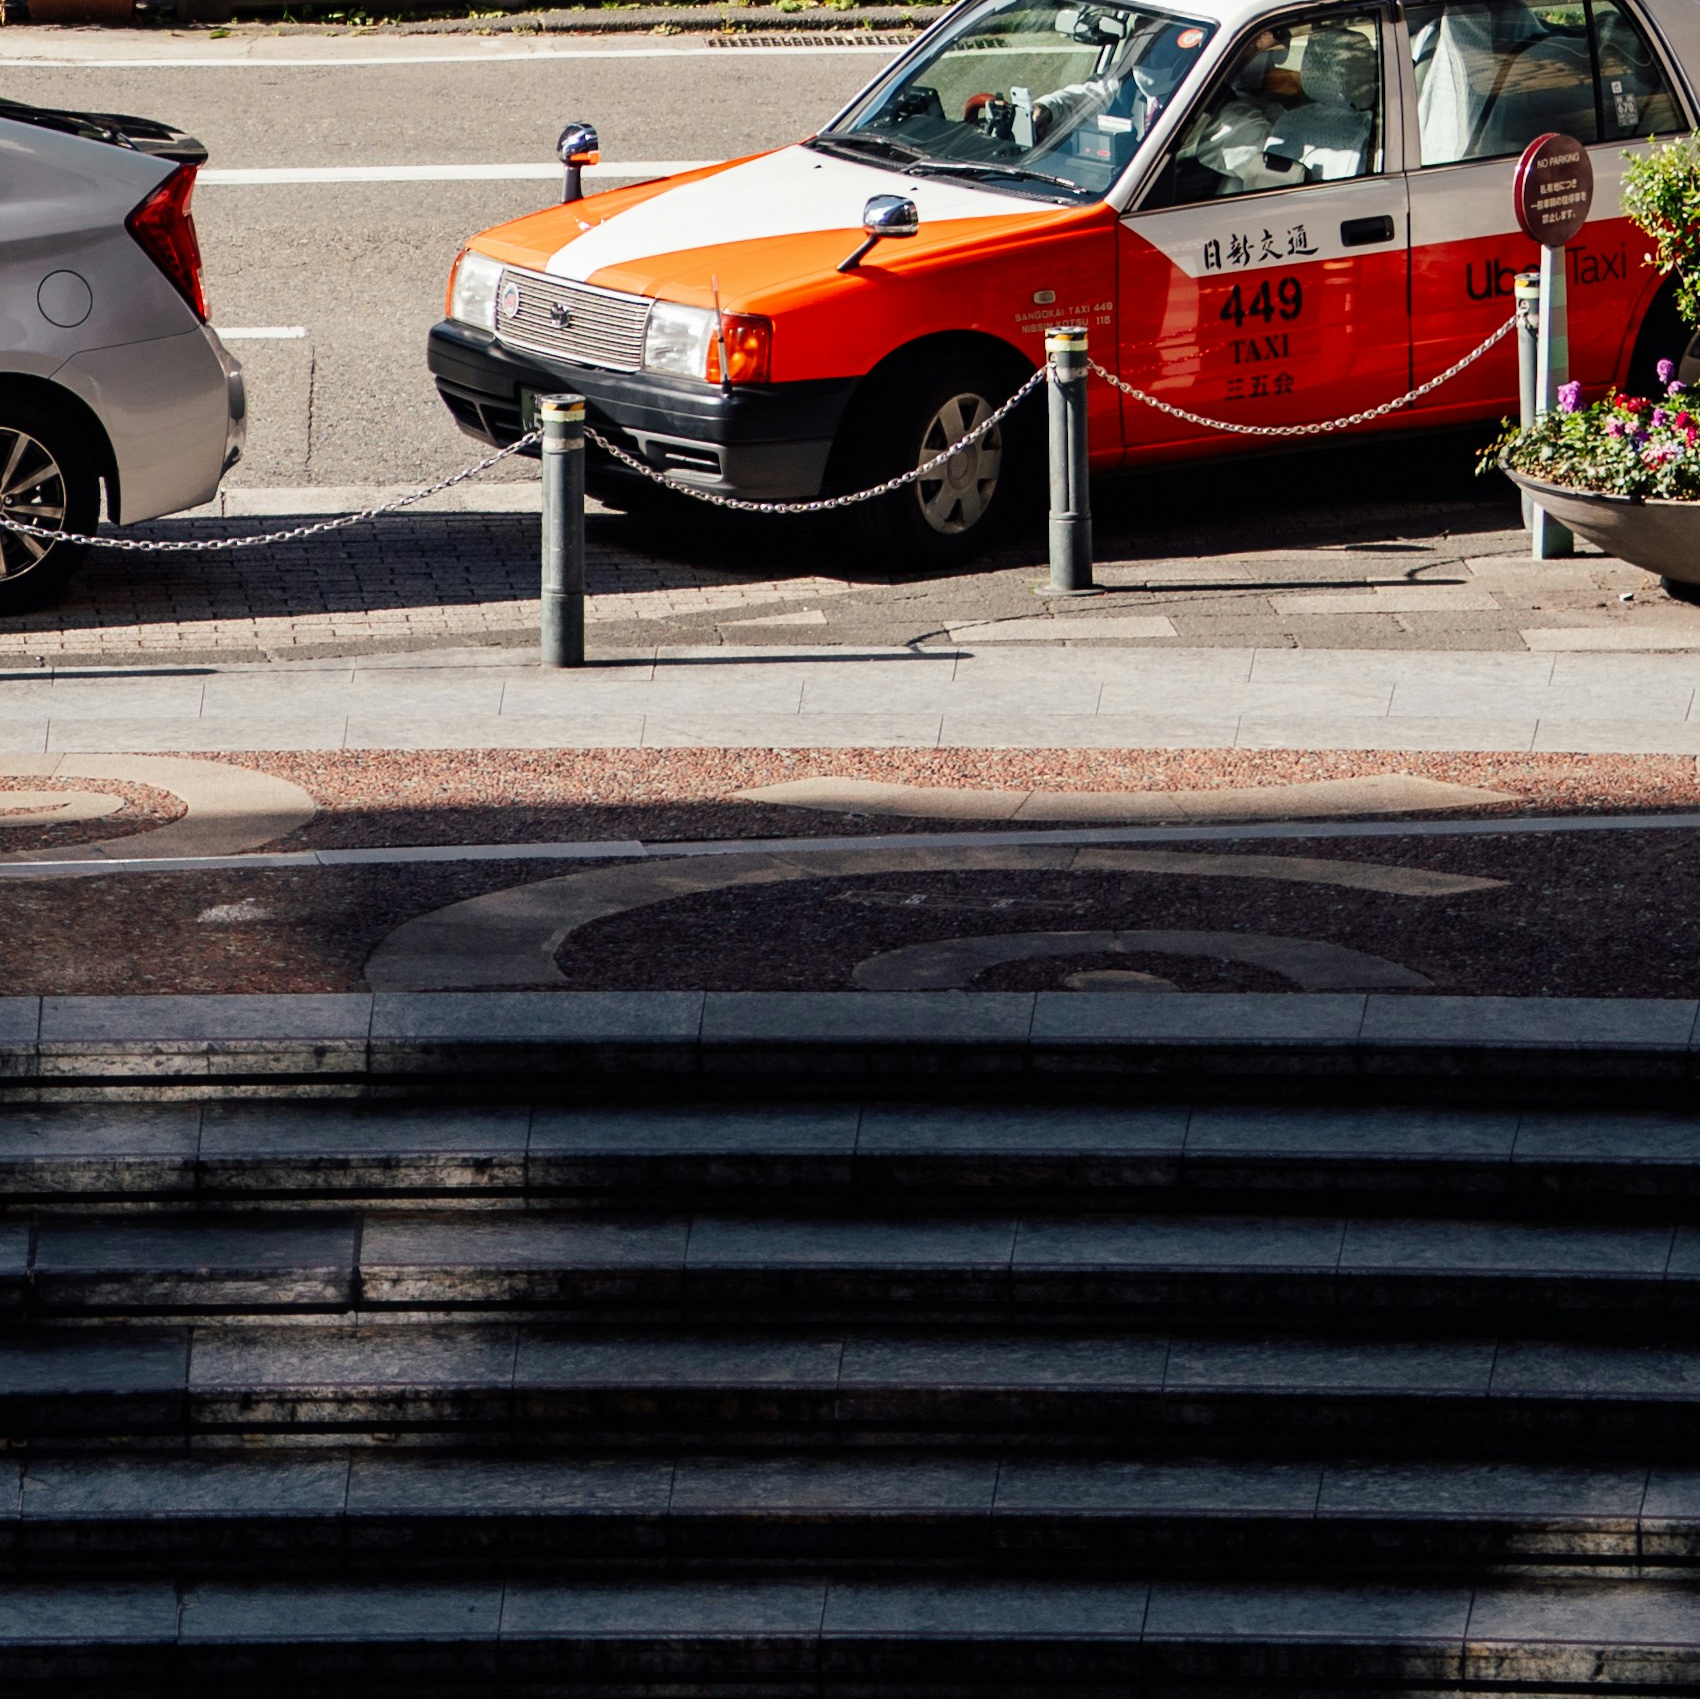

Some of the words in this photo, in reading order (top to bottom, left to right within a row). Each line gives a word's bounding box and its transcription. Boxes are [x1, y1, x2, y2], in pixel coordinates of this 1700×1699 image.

[1537, 158, 1549, 169] NO
[1203, 224, 1320, 270] 日新交通
[1466, 257, 1541, 300] Ub
[1565, 242, 1628, 286] Taxi
[1068, 304, 1091, 315] TAXI
[1220, 276, 1303, 328] 449
[1229, 334, 1290, 364] TAXI
[1224, 370, 1295, 401] 三五会
